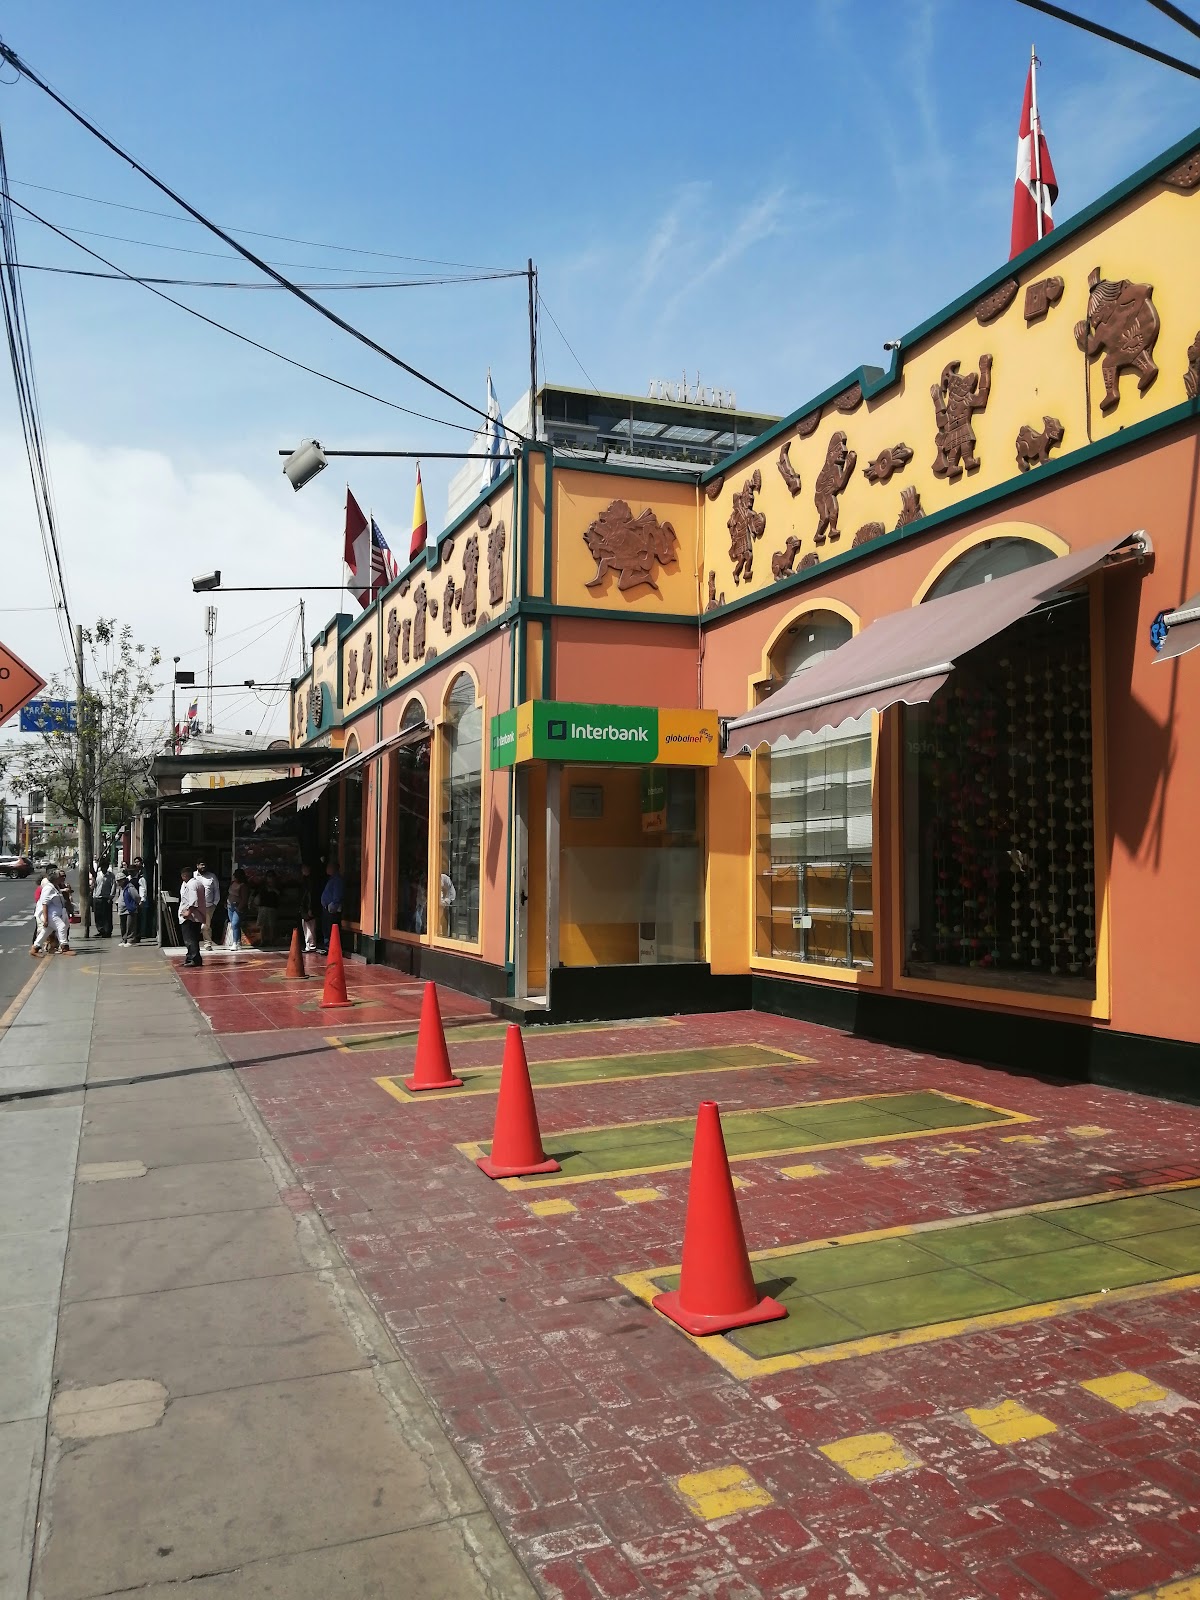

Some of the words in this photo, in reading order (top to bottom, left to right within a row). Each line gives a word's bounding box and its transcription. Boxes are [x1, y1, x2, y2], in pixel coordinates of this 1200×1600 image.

[23, 706, 66, 716] PARAERO
[571, 723, 649, 742] Interbank
[665, 734, 703, 744] globalnet
